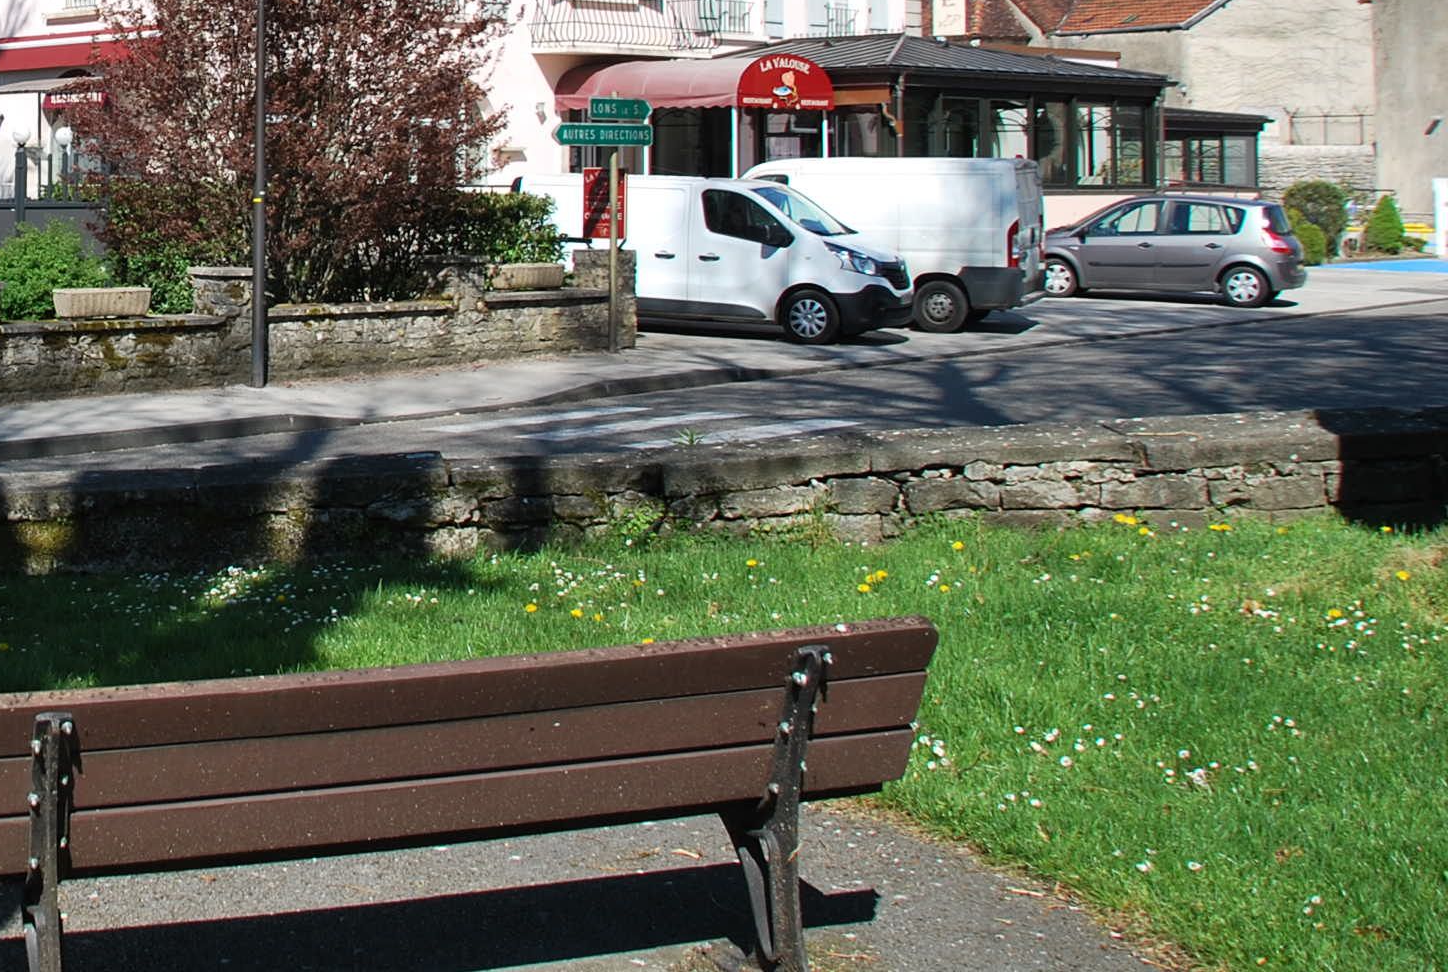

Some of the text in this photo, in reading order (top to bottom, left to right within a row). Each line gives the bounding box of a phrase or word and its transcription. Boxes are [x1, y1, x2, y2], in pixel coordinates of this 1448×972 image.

[760, 57, 810, 74] LA VALOUSE
[593, 104, 617, 114] LONS
[563, 129, 650, 141] AUTRES DIRECTIONS
